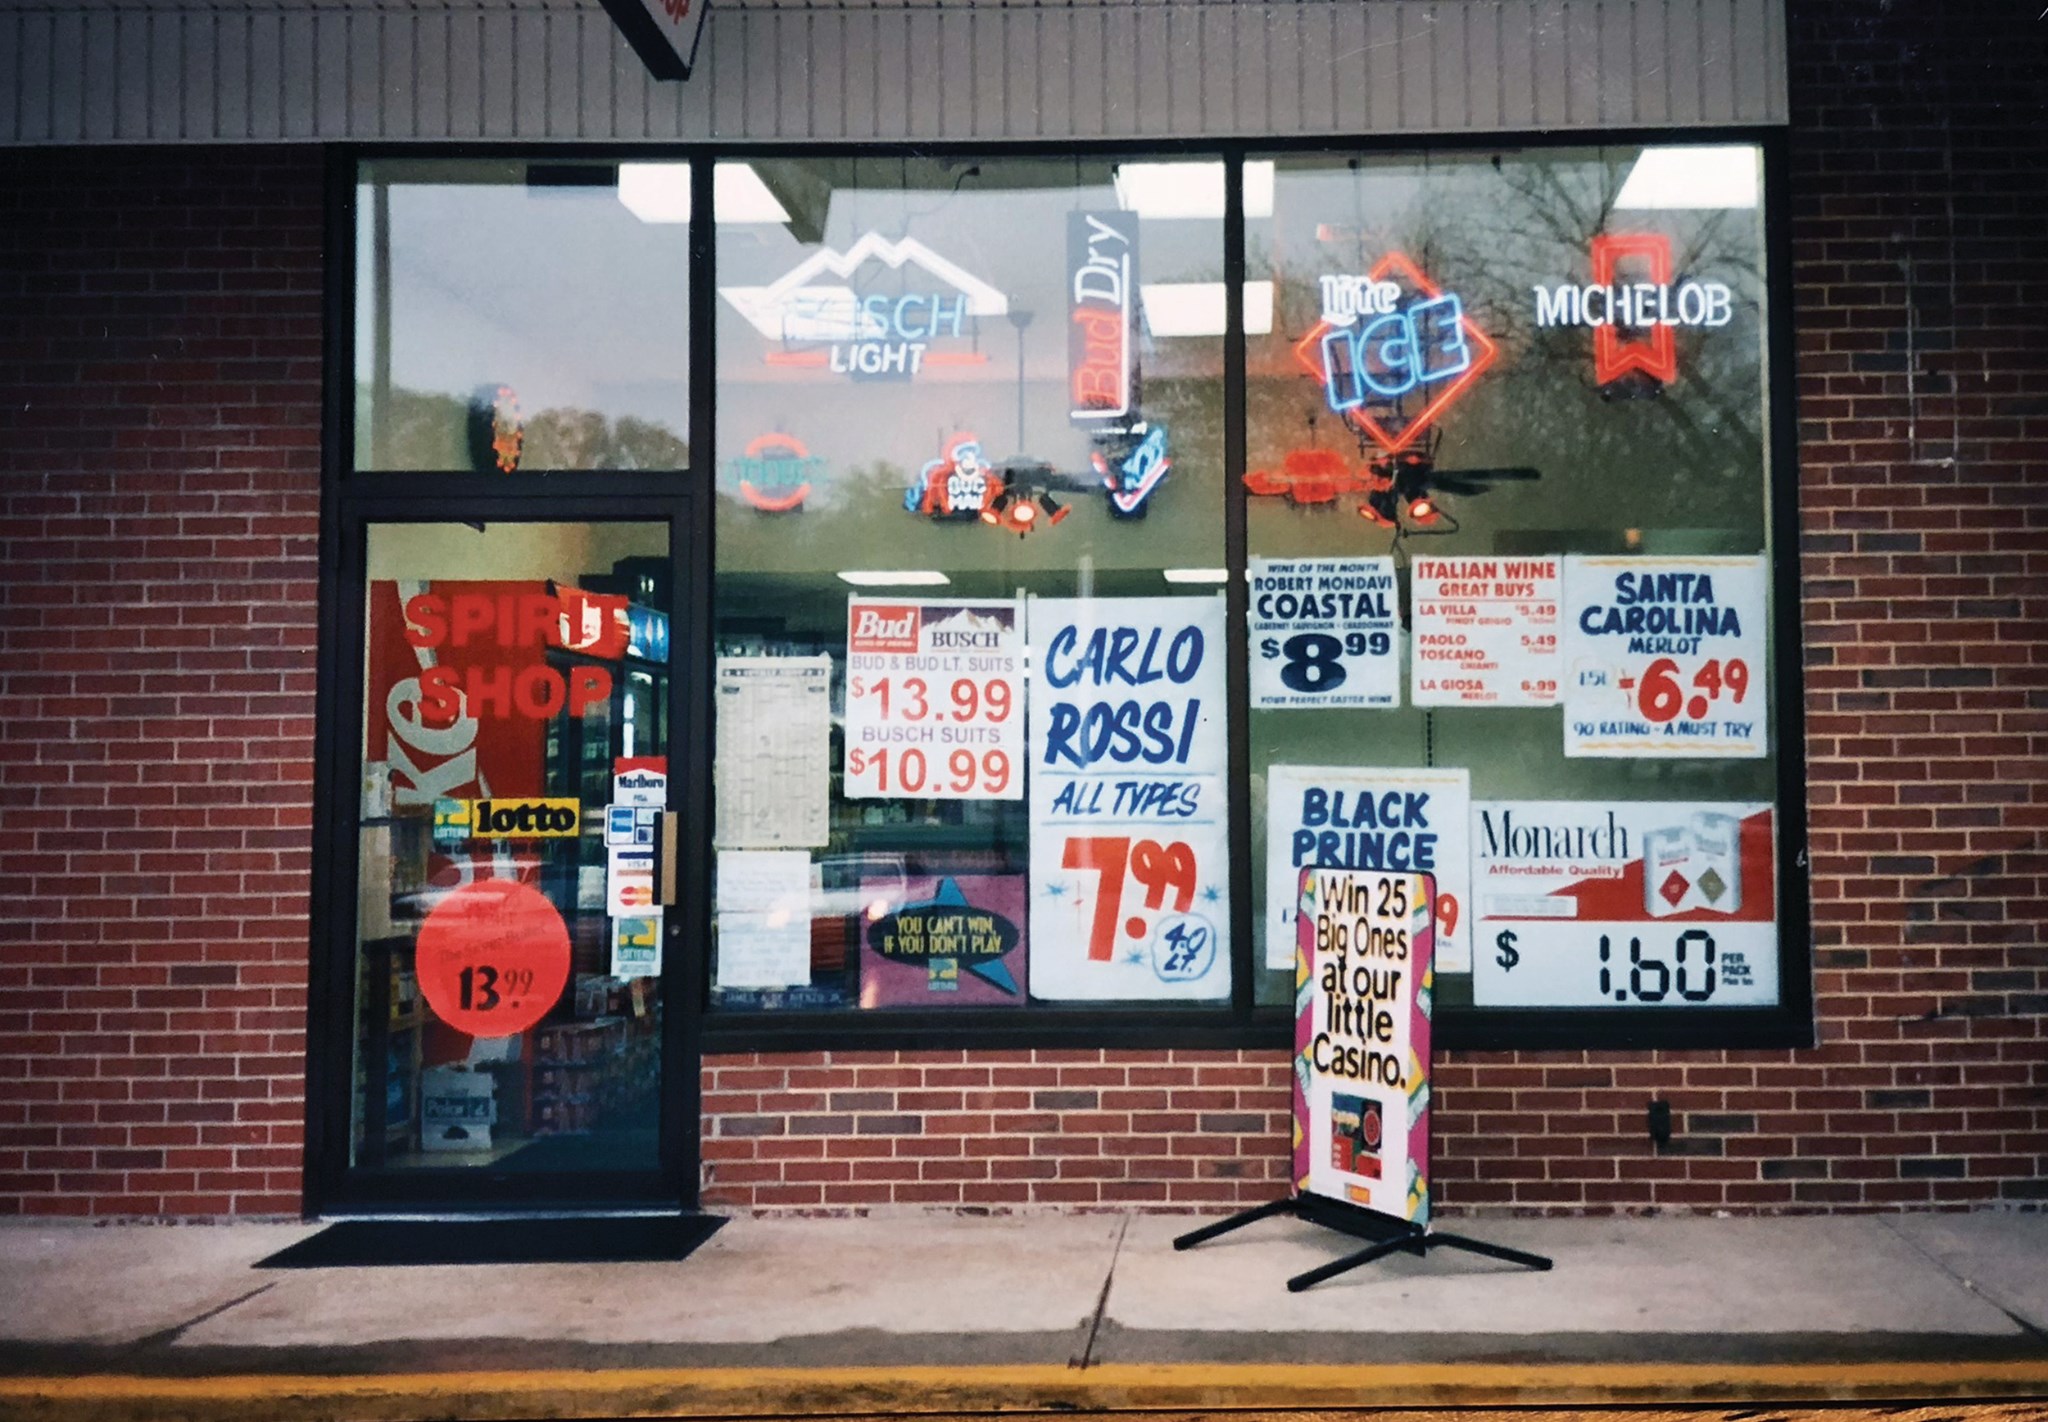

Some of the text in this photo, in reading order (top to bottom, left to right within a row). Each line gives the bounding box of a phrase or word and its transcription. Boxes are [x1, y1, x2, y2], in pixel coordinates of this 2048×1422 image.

[1073, 215, 1130, 405] Bud Dry
[1534, 283, 1732, 328] MICHELOB
[830, 342, 927, 374] LIGHT
[1321, 293, 1470, 410] ICE
[1254, 576, 1392, 591] ROBERT MONDAVI
[1418, 562, 1556, 579] ITALIAN WINE
[1438, 582, 1535, 597] GREAT BUYS
[1615, 571, 1715, 605] SANTA
[405, 592, 630, 649] SPIRIT
[1257, 593, 1392, 620] COASTAL
[1419, 605, 1435, 615] LA
[1440, 605, 1477, 615] VILLA
[1579, 605, 1741, 638] CAROLINA
[853, 610, 915, 638] Bud
[931, 631, 999, 648] BUSCH
[1045, 624, 1204, 688] CARLO
[1419, 635, 1557, 646] PAOLO 5.49
[1419, 649, 1485, 660] TOSCANO
[1628, 637, 1703, 655] MERLOT
[851, 656, 885, 670] BUD
[889, 656, 900, 670] &
[906, 656, 938, 671] BUD
[969, 656, 1014, 672] SUITS
[418, 666, 613, 721] SHOP
[1420, 679, 1557, 691] LA GIOSA 6.99
[862, 727, 1001, 744] BUSCH SUITS
[1044, 698, 1201, 769] ROSSI
[1574, 722, 1594, 736] 90
[1600, 722, 1650, 735] RATING
[1664, 722, 1674, 735] A
[1677, 721, 1716, 737] MUST
[1724, 722, 1753, 738] TRY
[618, 774, 664, 789] Marlboro
[1051, 781, 1201, 817] ALL TYPES
[1302, 788, 1430, 829] BLACK
[477, 801, 576, 832] lotto
[1292, 829, 1438, 870] PRINCE
[1480, 810, 1629, 859] Monarch
[1488, 864, 1623, 878] Affordable Quality
[1321, 874, 1407, 918] Win 25
[896, 916, 922, 934] YOU
[927, 915, 963, 934] CAN'T
[1317, 914, 1408, 960] Big Ones
[884, 936, 895, 953] IF
[898, 936, 924, 954] YOU
[929, 935, 966, 954] DON'T
[1721, 953, 1744, 964] PER
[1321, 958, 1402, 1001] at our
[1495, 929, 1716, 1001] $ 1.60
[1722, 965, 1751, 976] PACK
[1326, 993, 1393, 1043] little
[1313, 1033, 1406, 1089] Casino.
